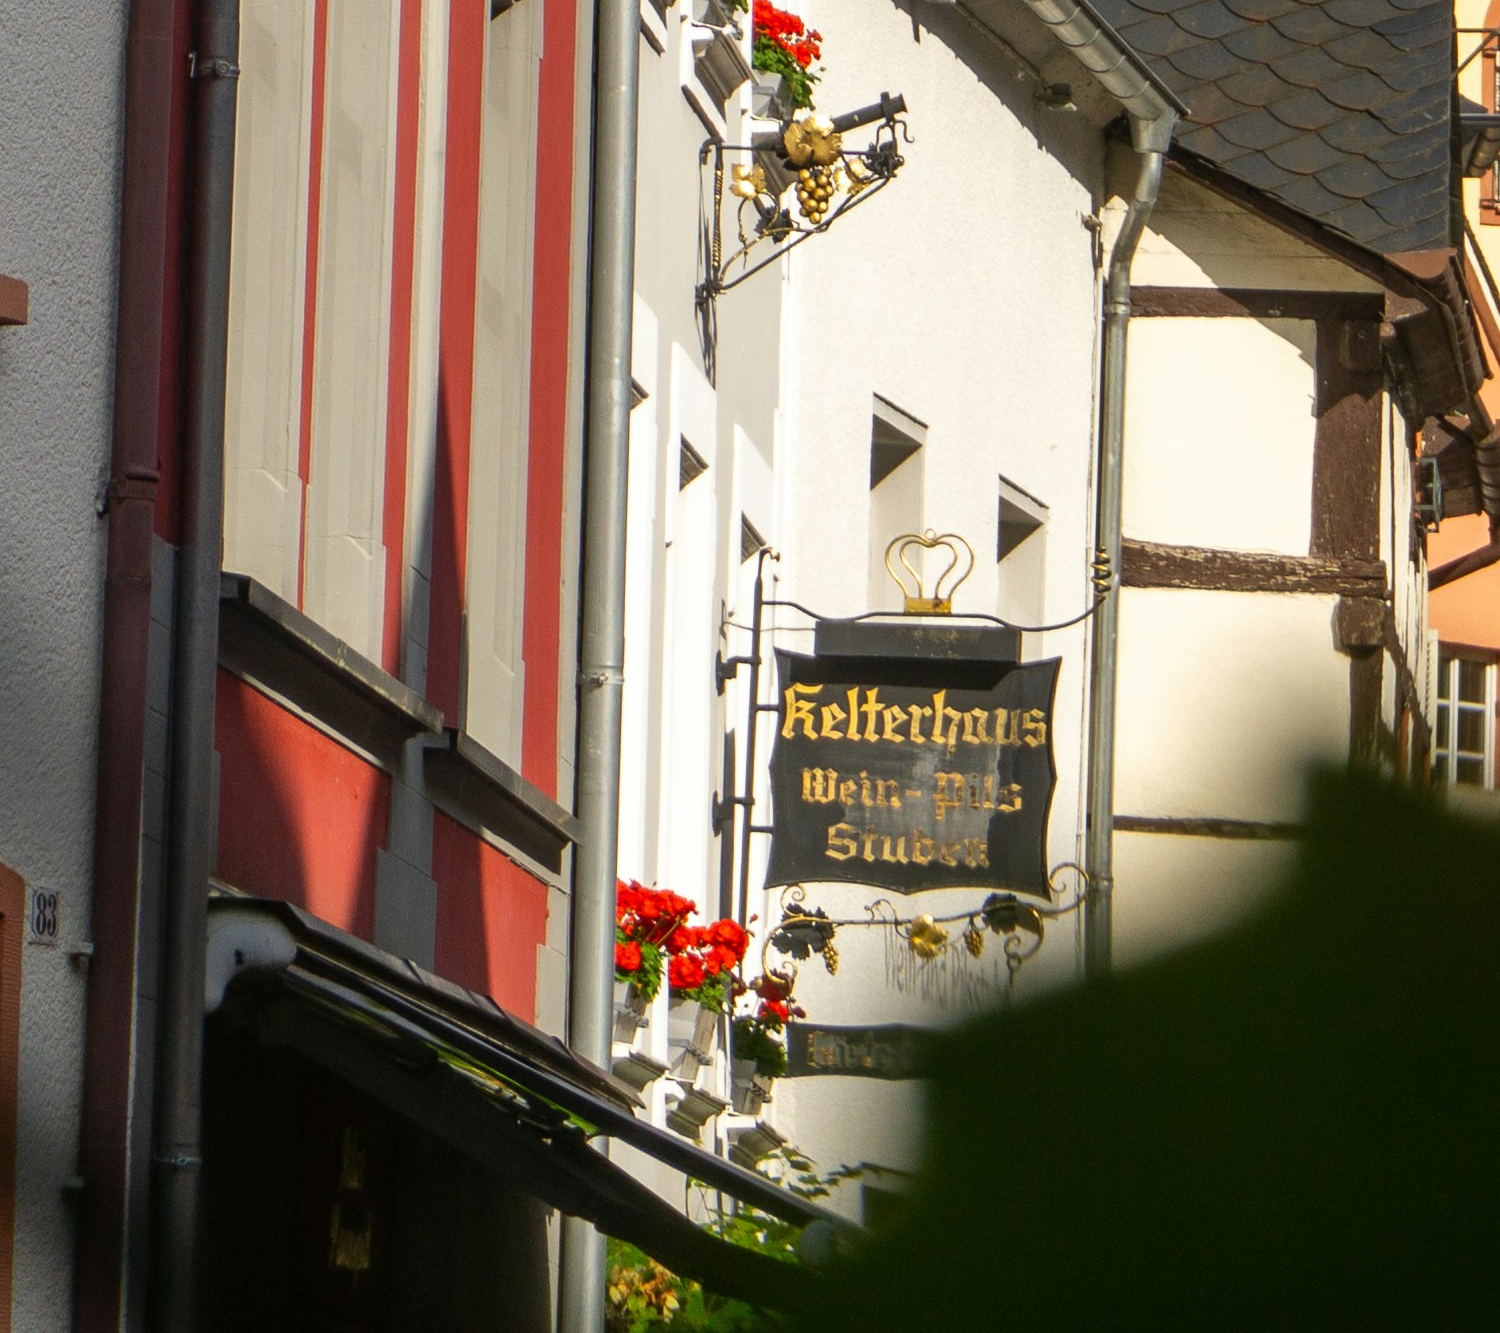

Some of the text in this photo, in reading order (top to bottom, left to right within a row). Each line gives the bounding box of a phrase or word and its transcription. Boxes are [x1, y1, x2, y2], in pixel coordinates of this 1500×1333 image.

[781, 683, 1047, 755] Kelterhaus
[932, 771, 1024, 821] Pils
[824, 821, 991, 869] Stuben
[36, 892, 57, 937] 83
